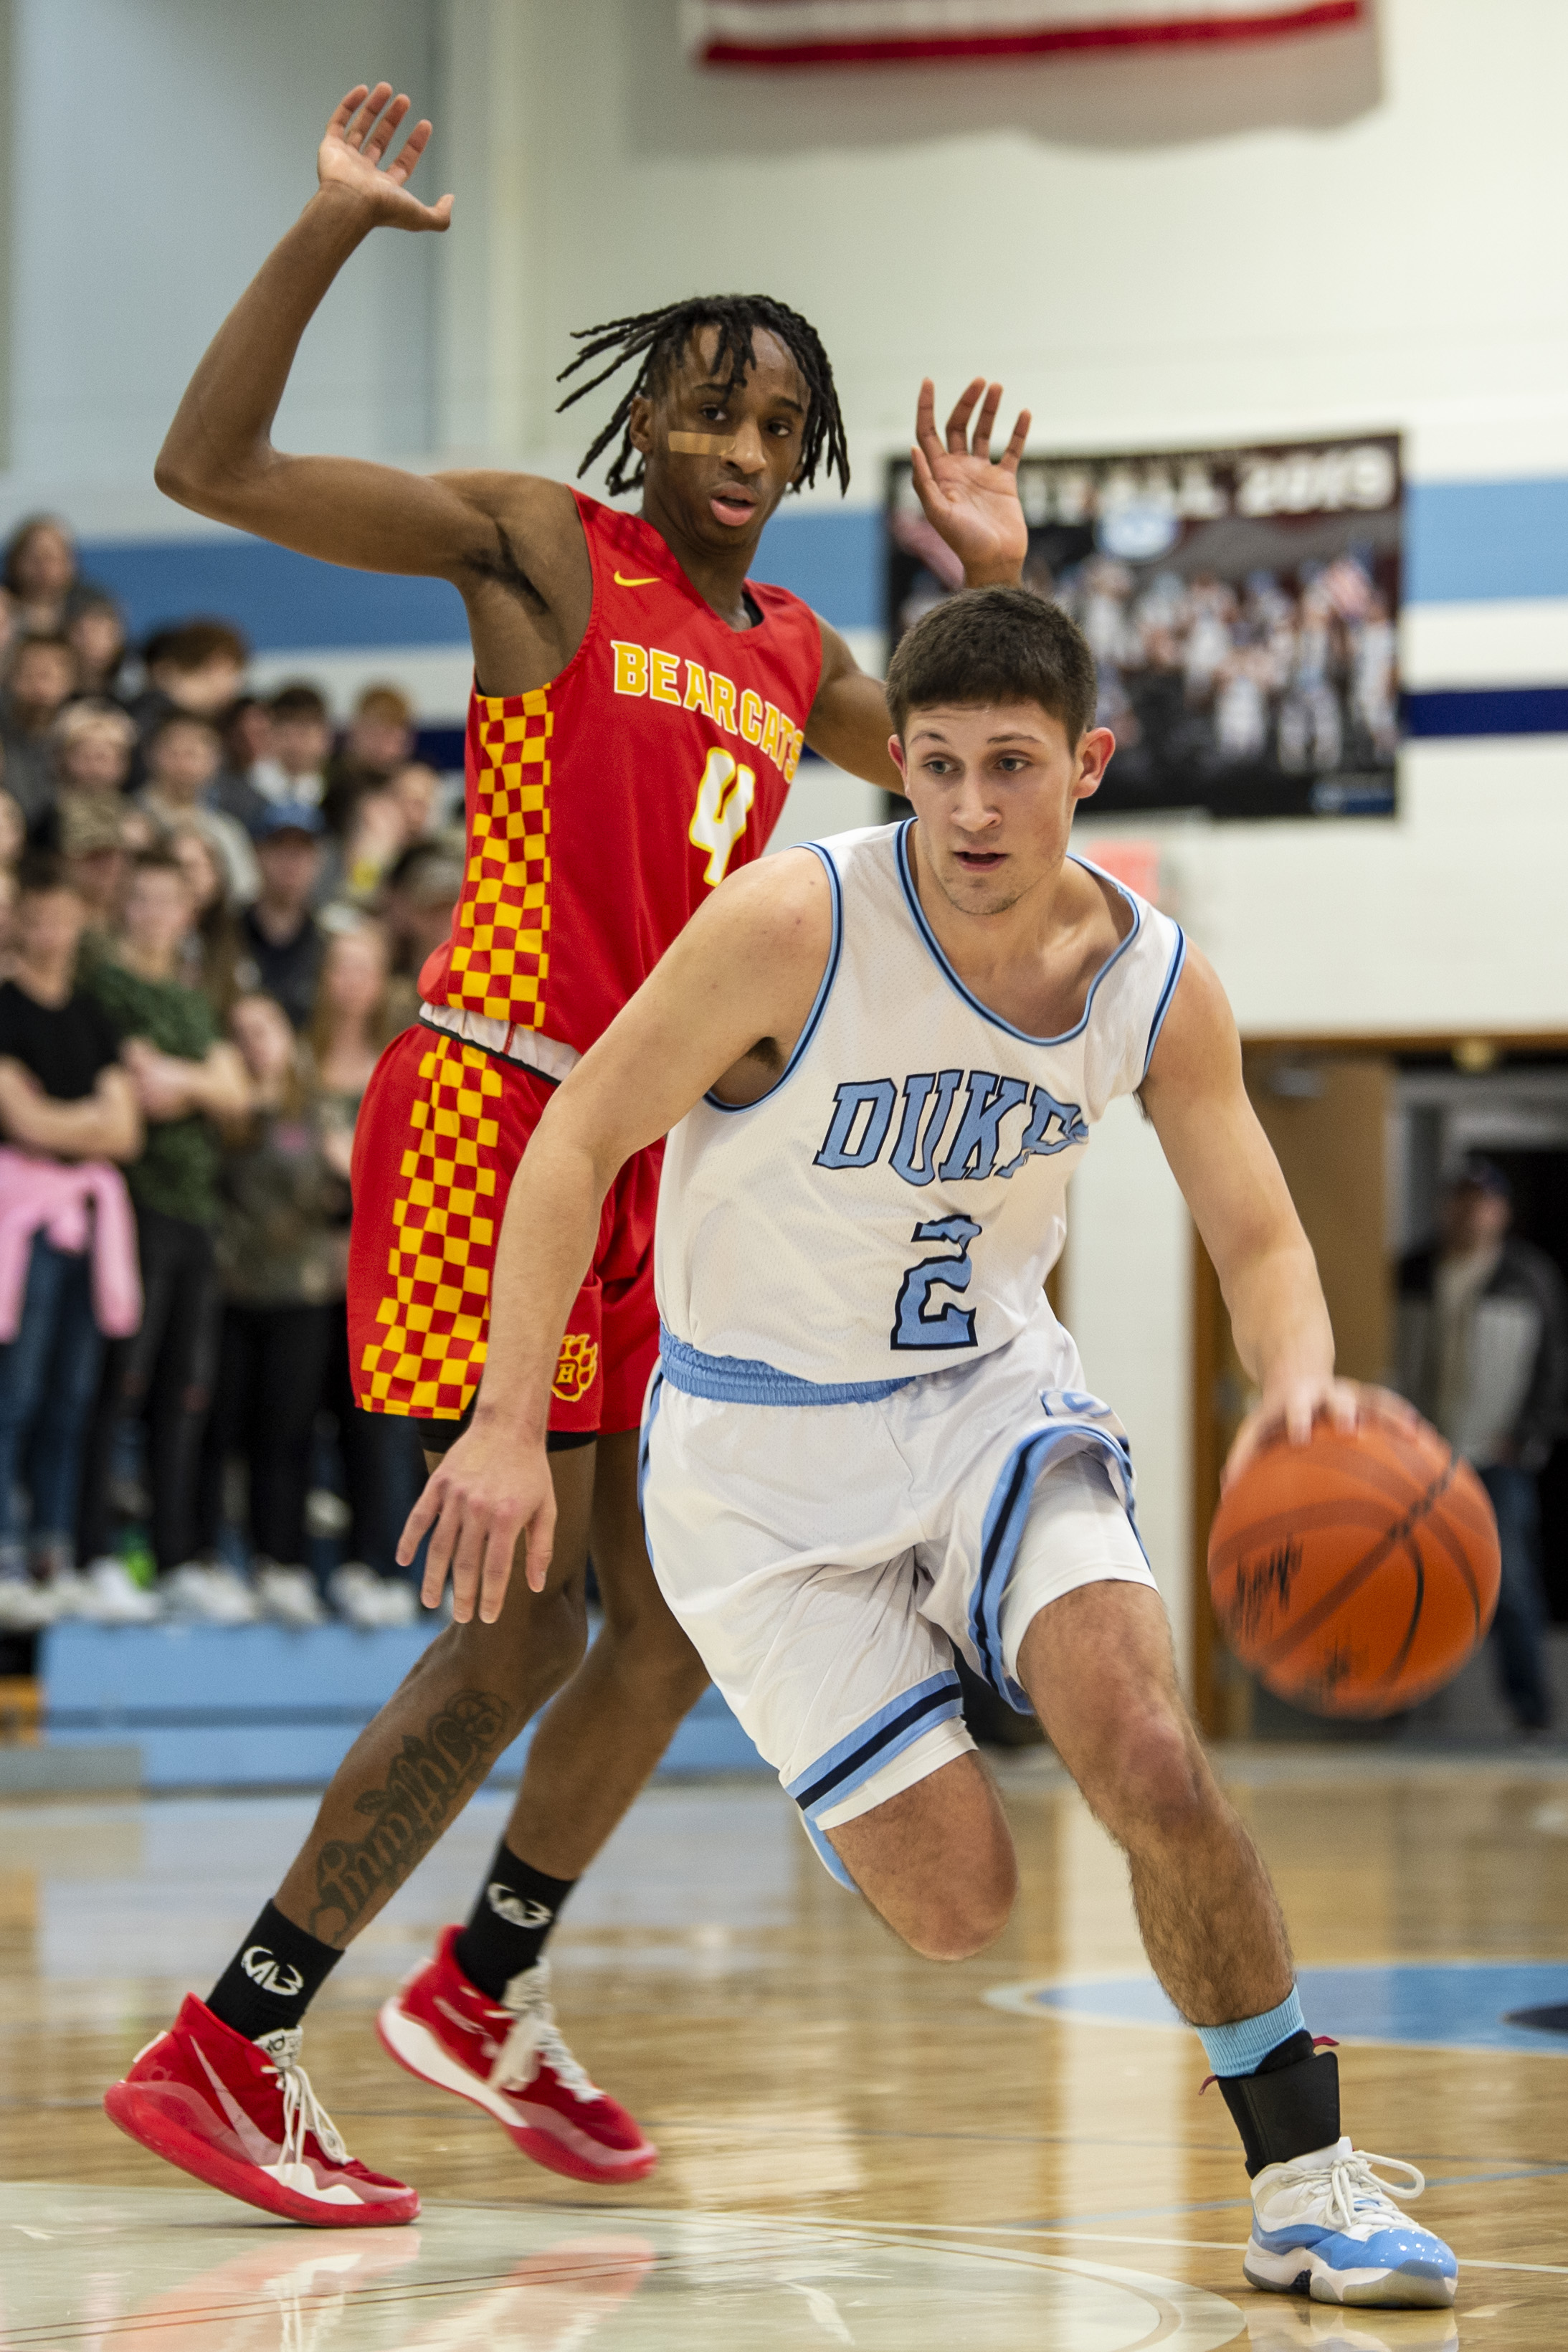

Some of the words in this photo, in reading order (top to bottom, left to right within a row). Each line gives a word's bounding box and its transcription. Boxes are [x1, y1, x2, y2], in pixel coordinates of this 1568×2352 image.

[610, 640, 805, 784] BEARCATS
[688, 746, 756, 887] 4
[812, 1068, 1090, 1187] DUKE
[890, 1214, 983, 1351] 2
